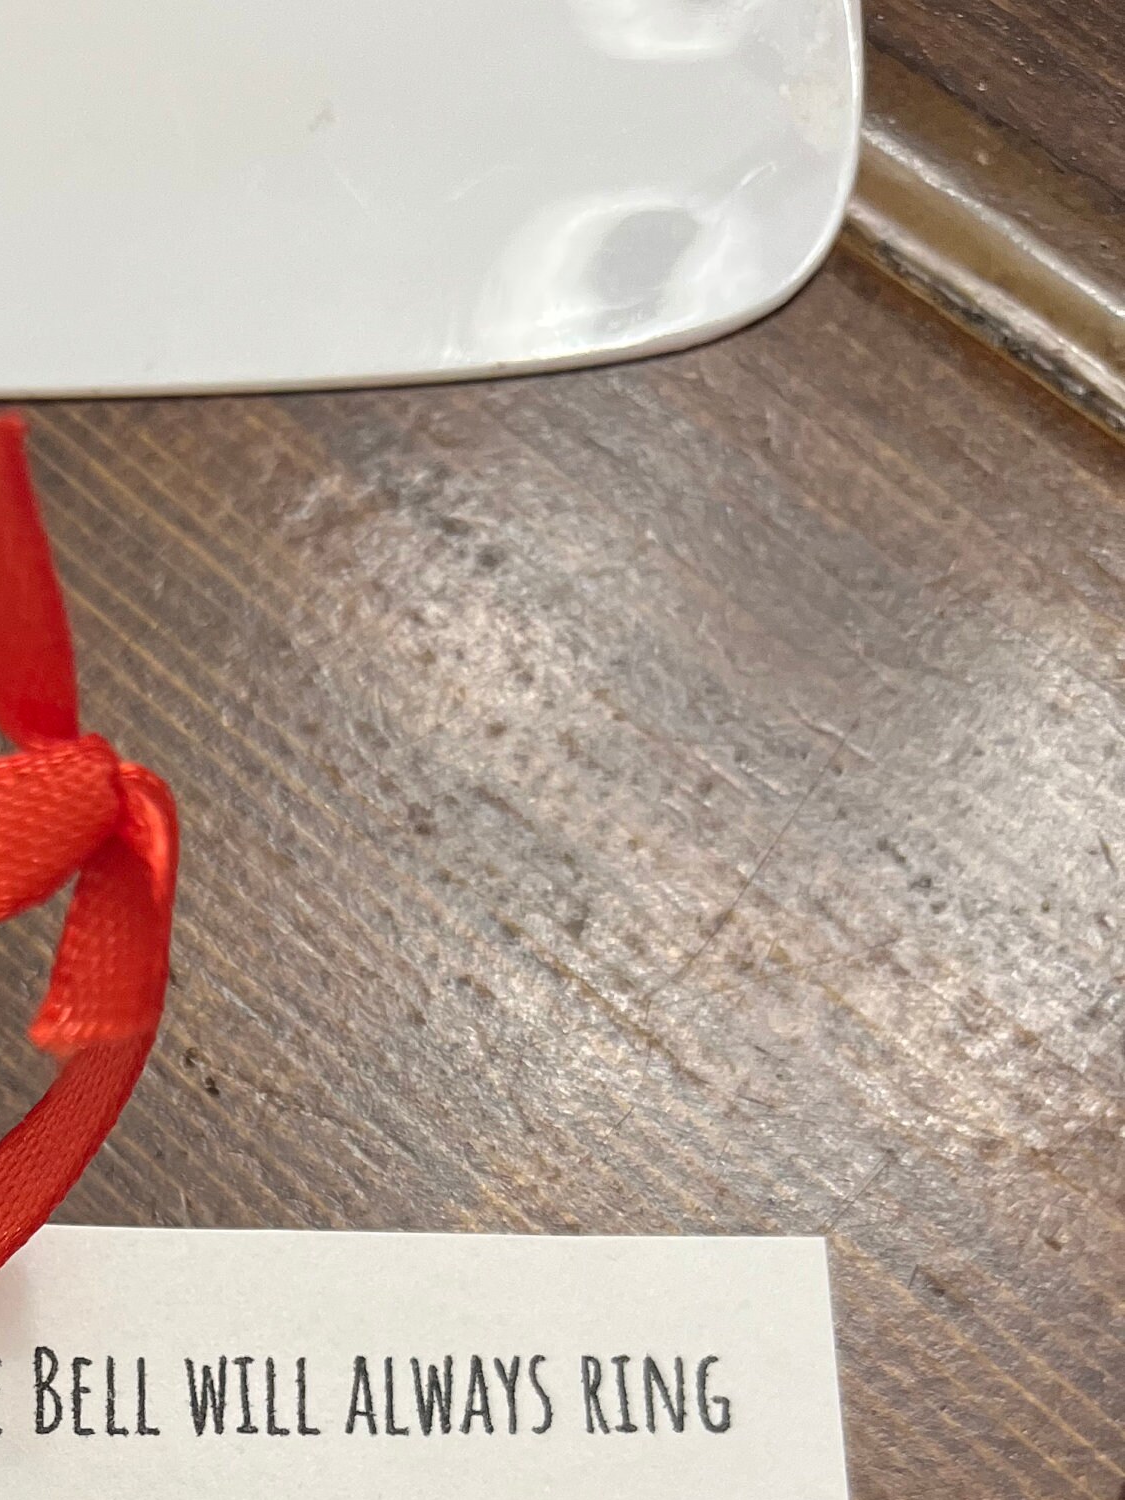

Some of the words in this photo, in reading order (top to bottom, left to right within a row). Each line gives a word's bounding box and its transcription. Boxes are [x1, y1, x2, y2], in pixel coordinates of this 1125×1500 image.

[32, 1345, 161, 1437] BELL
[184, 1355, 321, 1437] WILL
[345, 1354, 555, 1436] ALWAYS
[581, 1354, 733, 1435] RING
